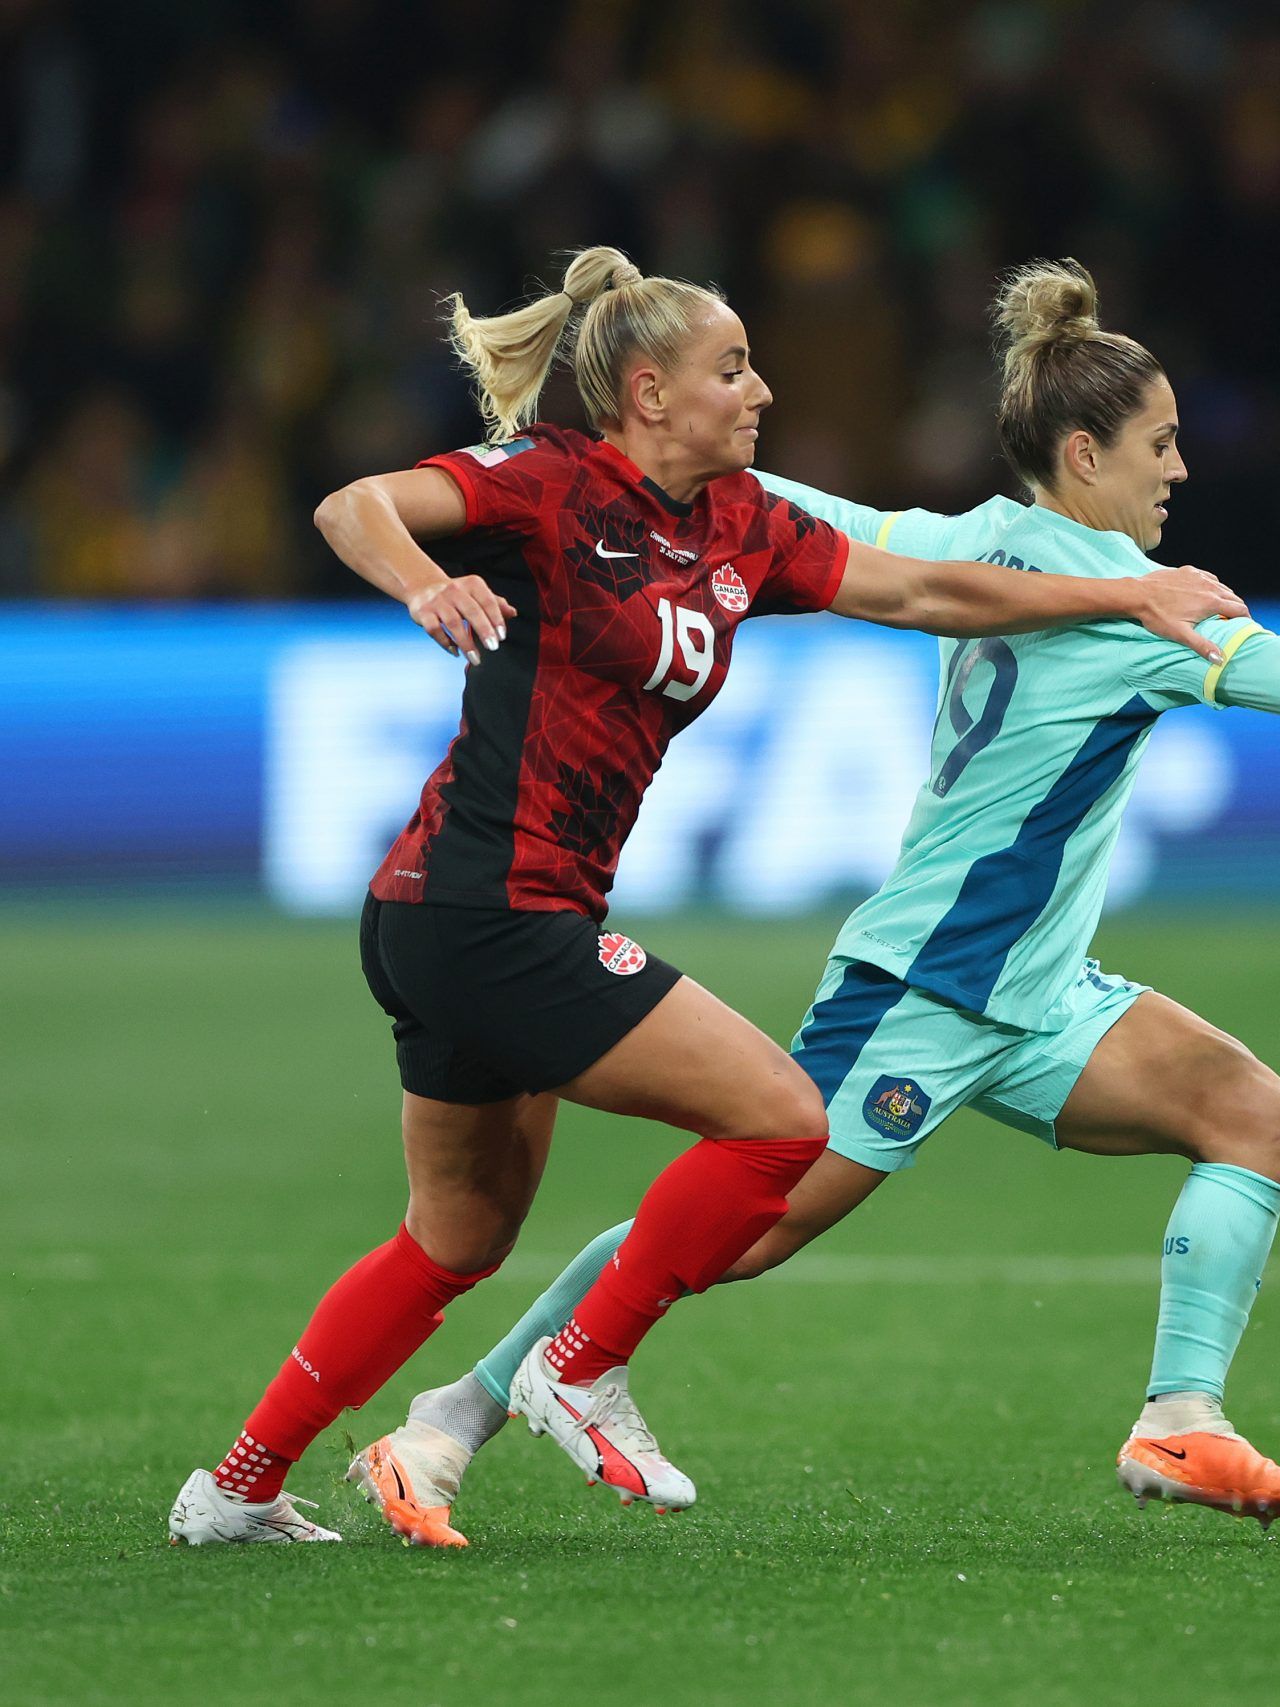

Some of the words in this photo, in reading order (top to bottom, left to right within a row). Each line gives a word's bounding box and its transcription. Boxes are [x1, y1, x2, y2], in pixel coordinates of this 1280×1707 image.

[714, 584, 745, 595] CANADA
[642, 597, 715, 702] 19
[873, 1106, 912, 1130] AUSTRALIA
